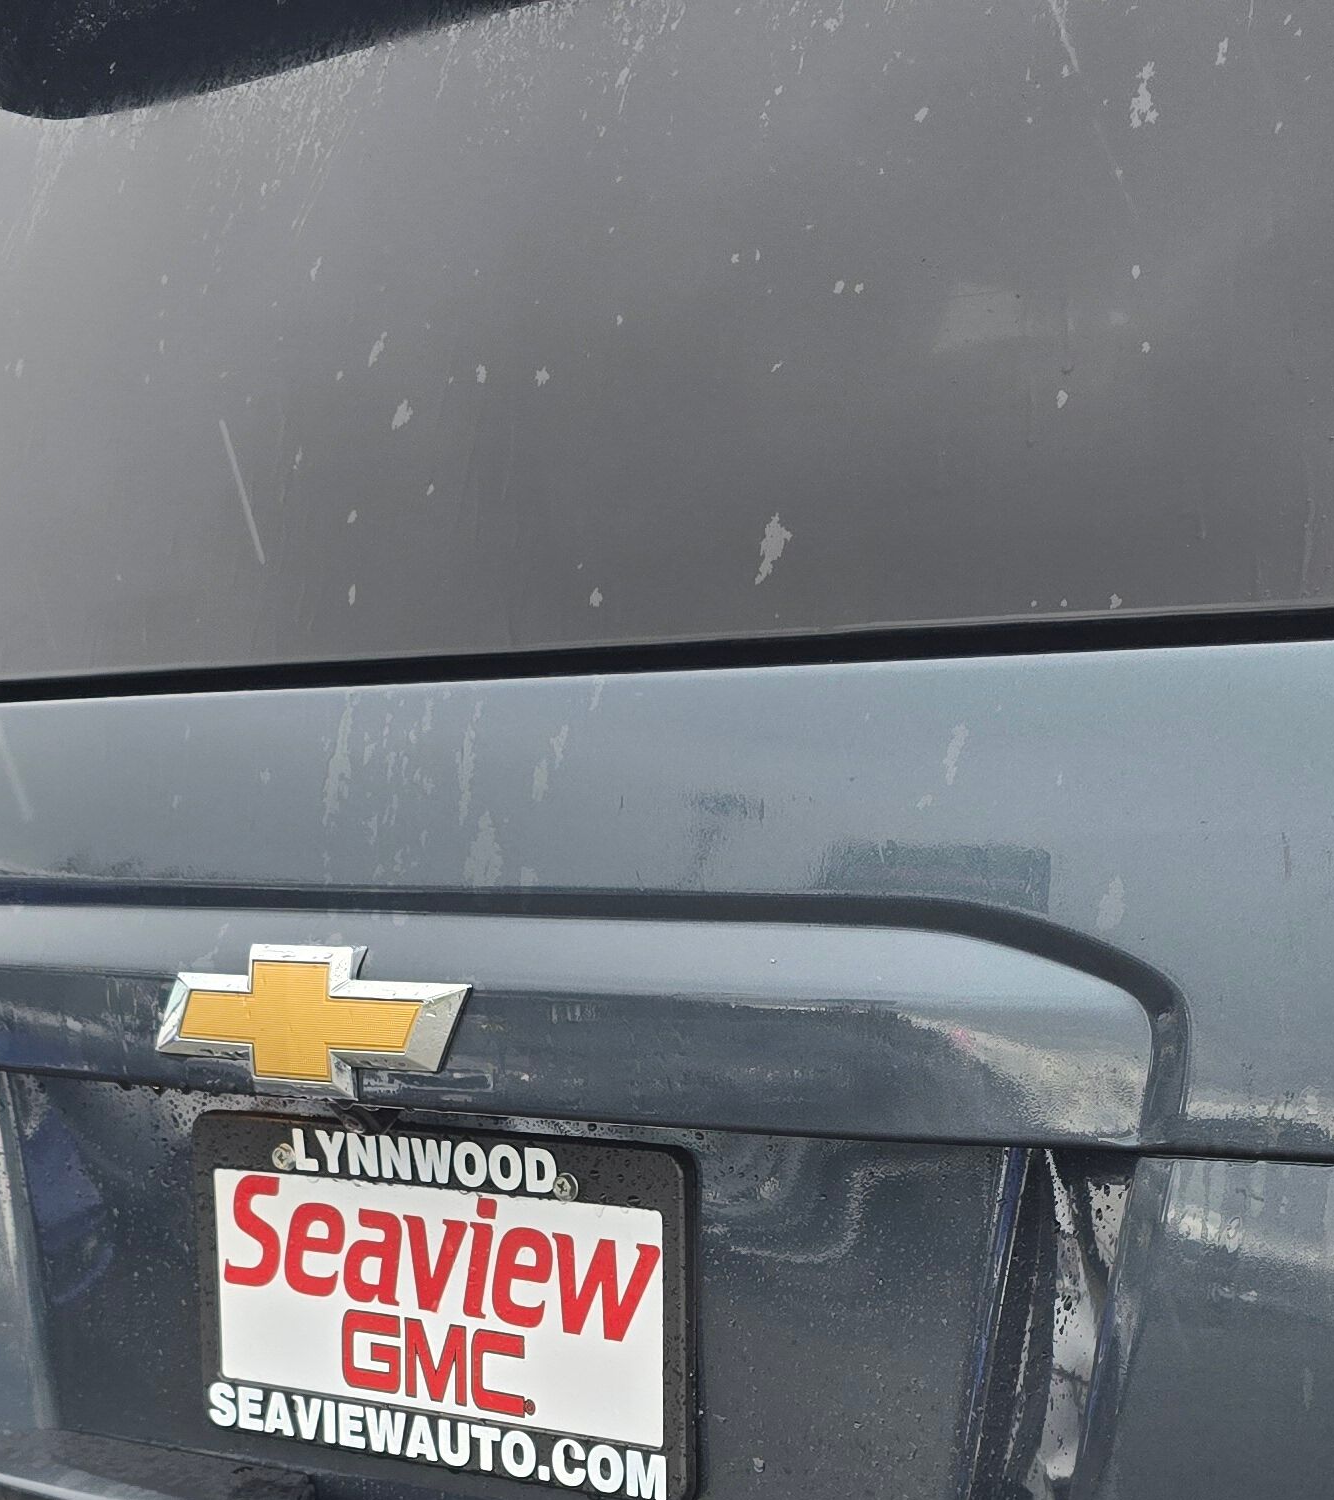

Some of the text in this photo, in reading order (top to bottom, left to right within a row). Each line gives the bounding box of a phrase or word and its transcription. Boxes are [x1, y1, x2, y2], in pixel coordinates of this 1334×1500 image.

[292, 1127, 557, 1194] LYNNWOOD
[223, 1173, 661, 1342] Seaview
[341, 1308, 529, 1417] GMC
